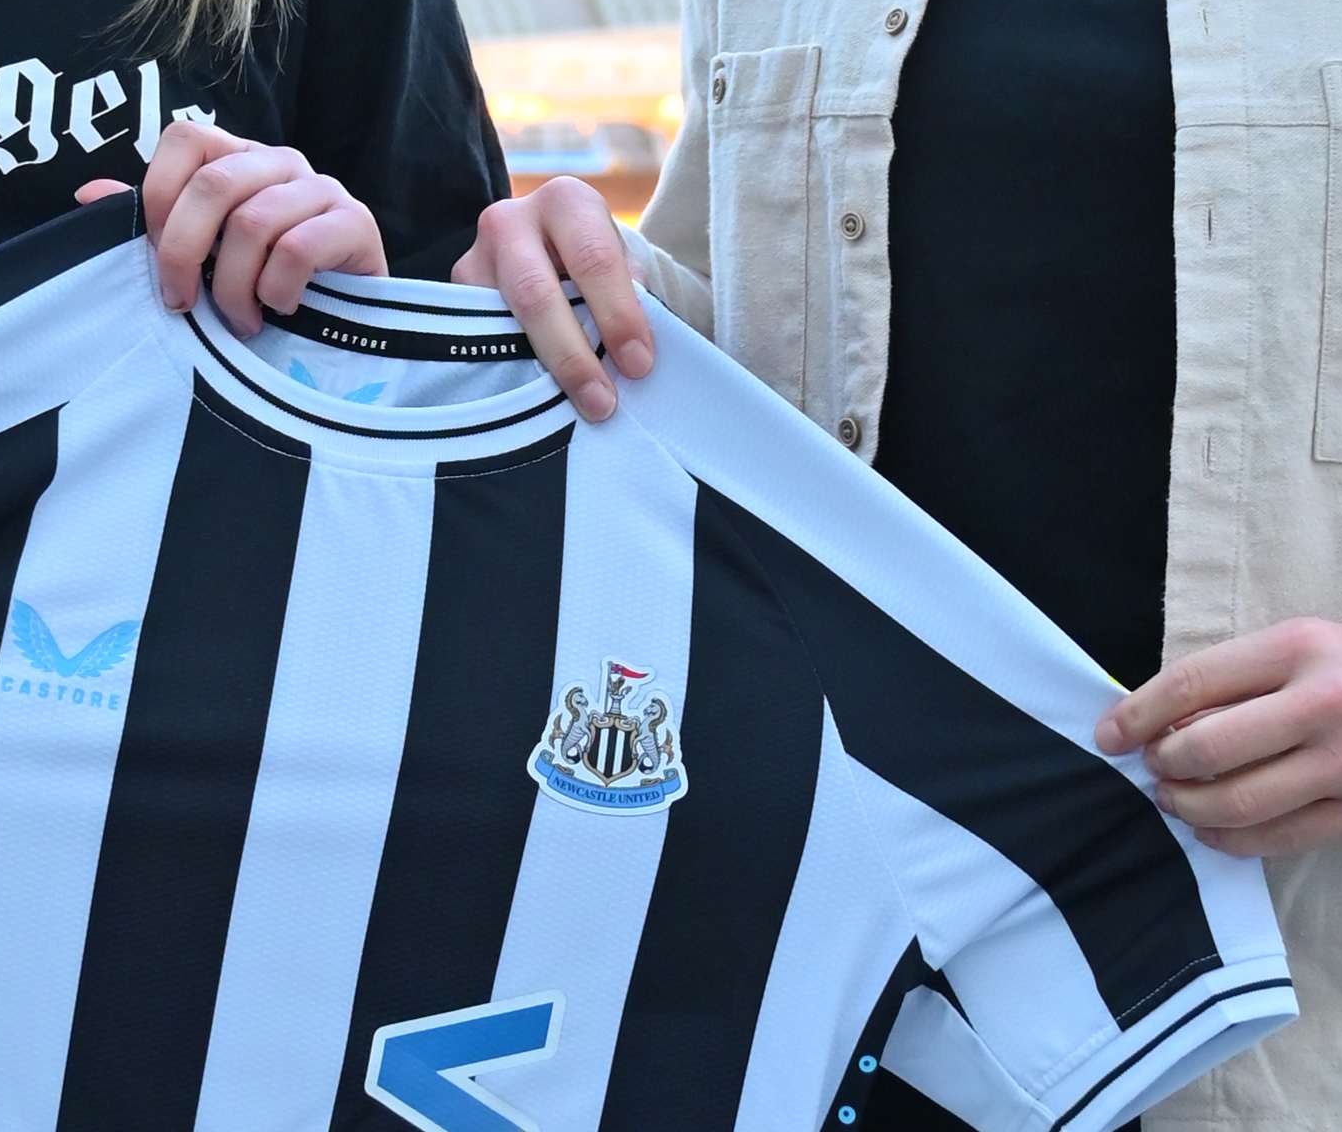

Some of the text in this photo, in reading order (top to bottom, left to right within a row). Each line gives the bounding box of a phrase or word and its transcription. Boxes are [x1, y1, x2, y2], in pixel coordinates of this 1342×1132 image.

[321, 327, 519, 356] CASTORE CASTORE
[1, 676, 120, 710] CASTORE
[553, 777, 660, 805] NEWCASTLE UNITED
